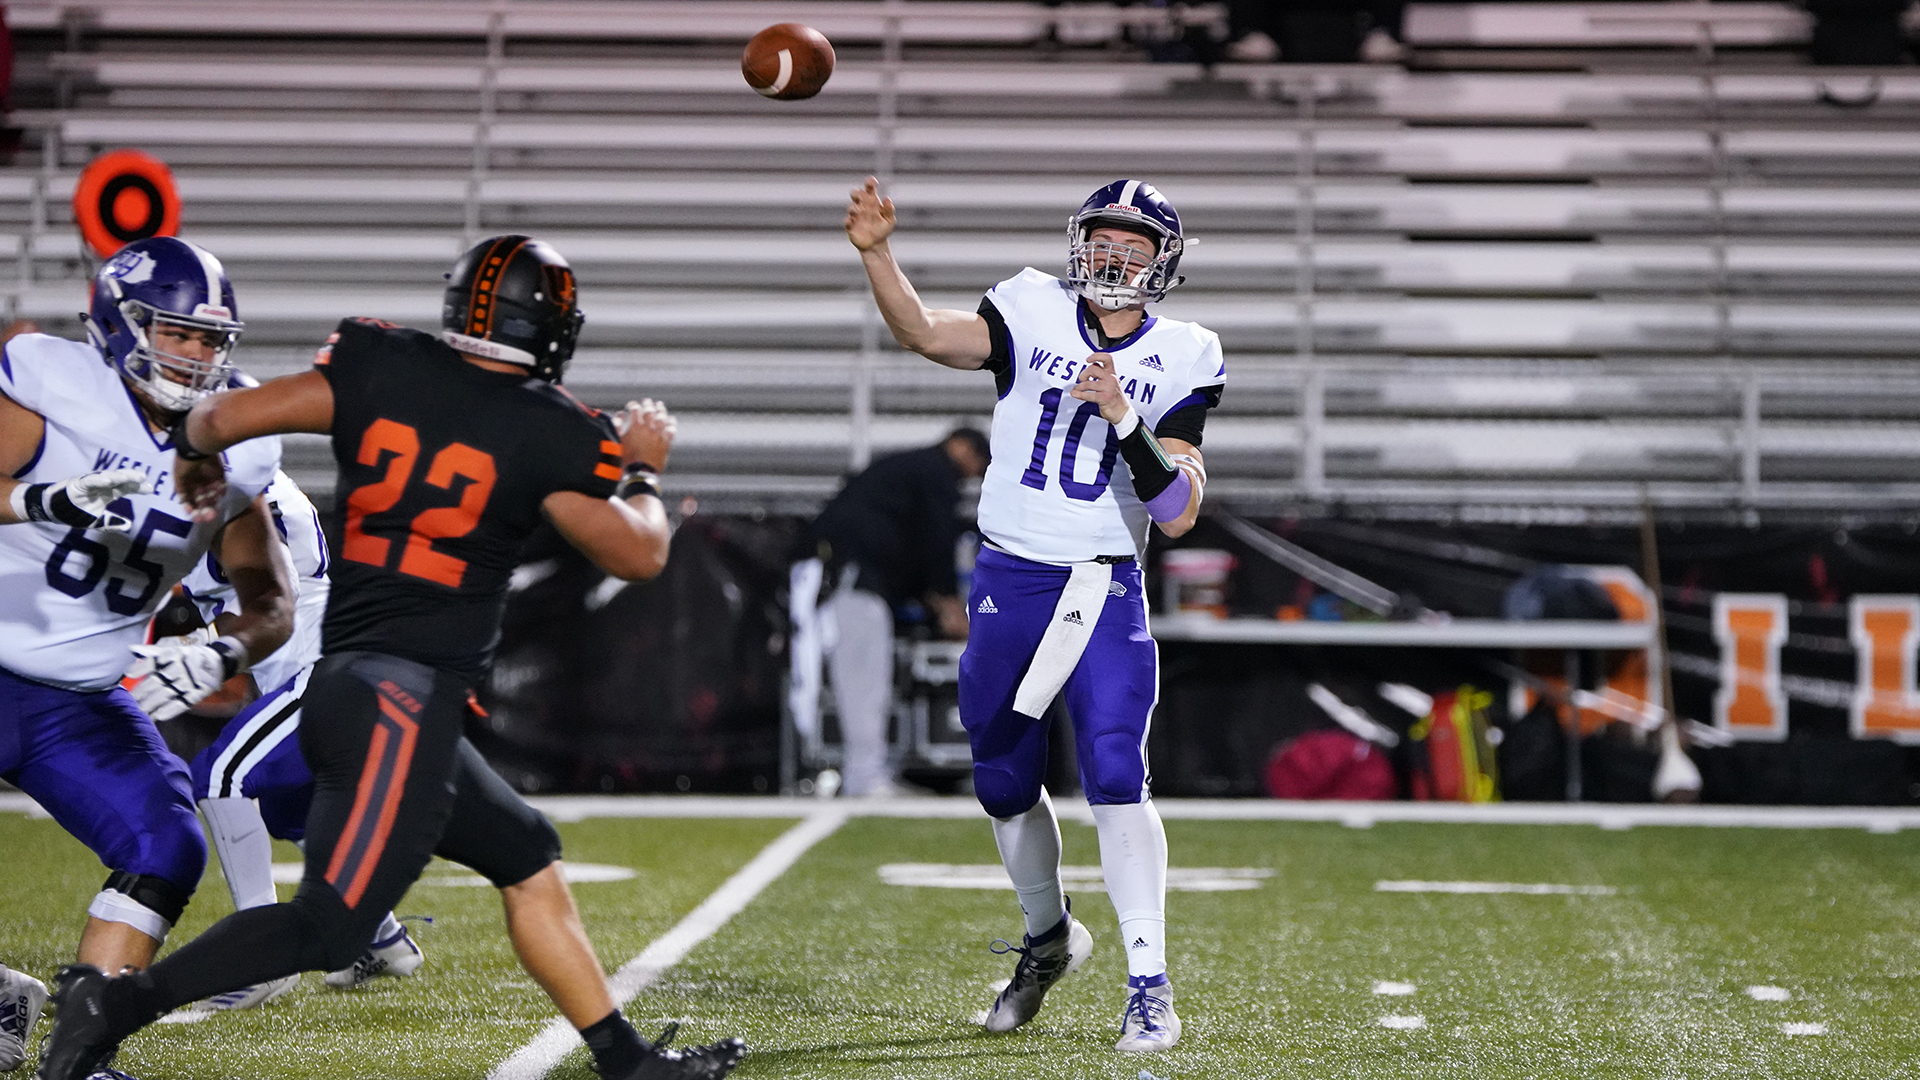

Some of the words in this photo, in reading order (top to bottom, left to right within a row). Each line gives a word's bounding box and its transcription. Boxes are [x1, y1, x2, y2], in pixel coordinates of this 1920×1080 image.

[1029, 347, 1157, 404] WESAN
[1139, 359, 1164, 372] adidas
[341, 417, 498, 588] 22
[1019, 387, 1121, 503] 10
[45, 496, 193, 617] 65
